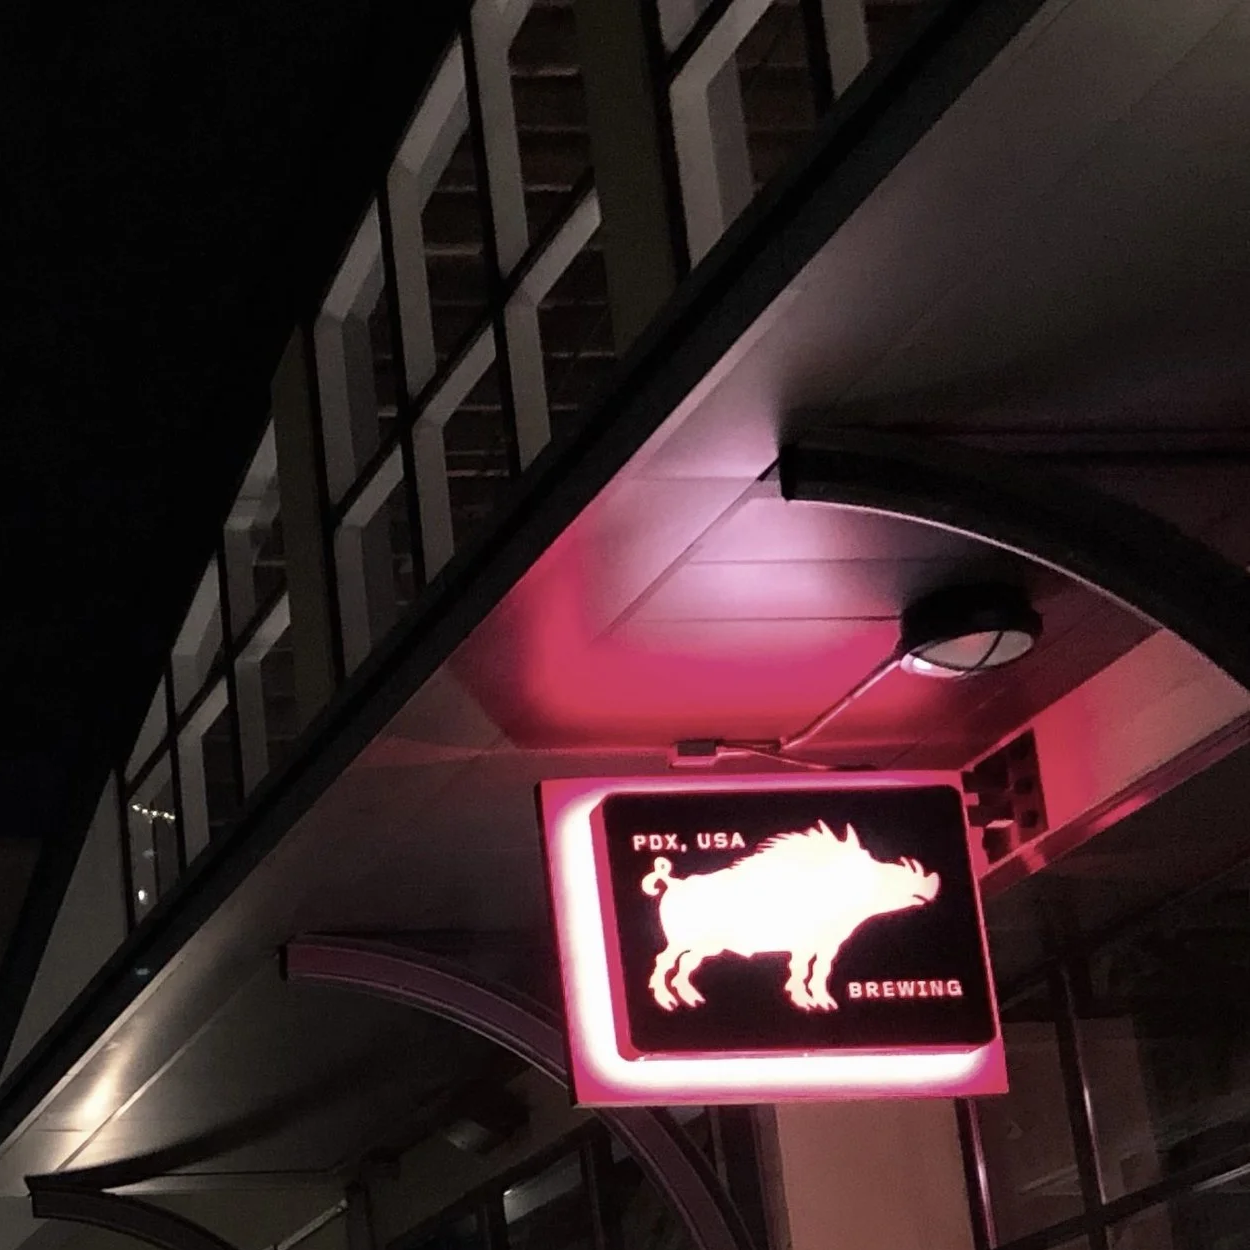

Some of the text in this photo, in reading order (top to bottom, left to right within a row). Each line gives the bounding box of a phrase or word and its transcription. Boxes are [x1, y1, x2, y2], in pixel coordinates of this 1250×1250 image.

[632, 831, 746, 853] PDX, USA
[848, 979, 963, 999] BREWING
